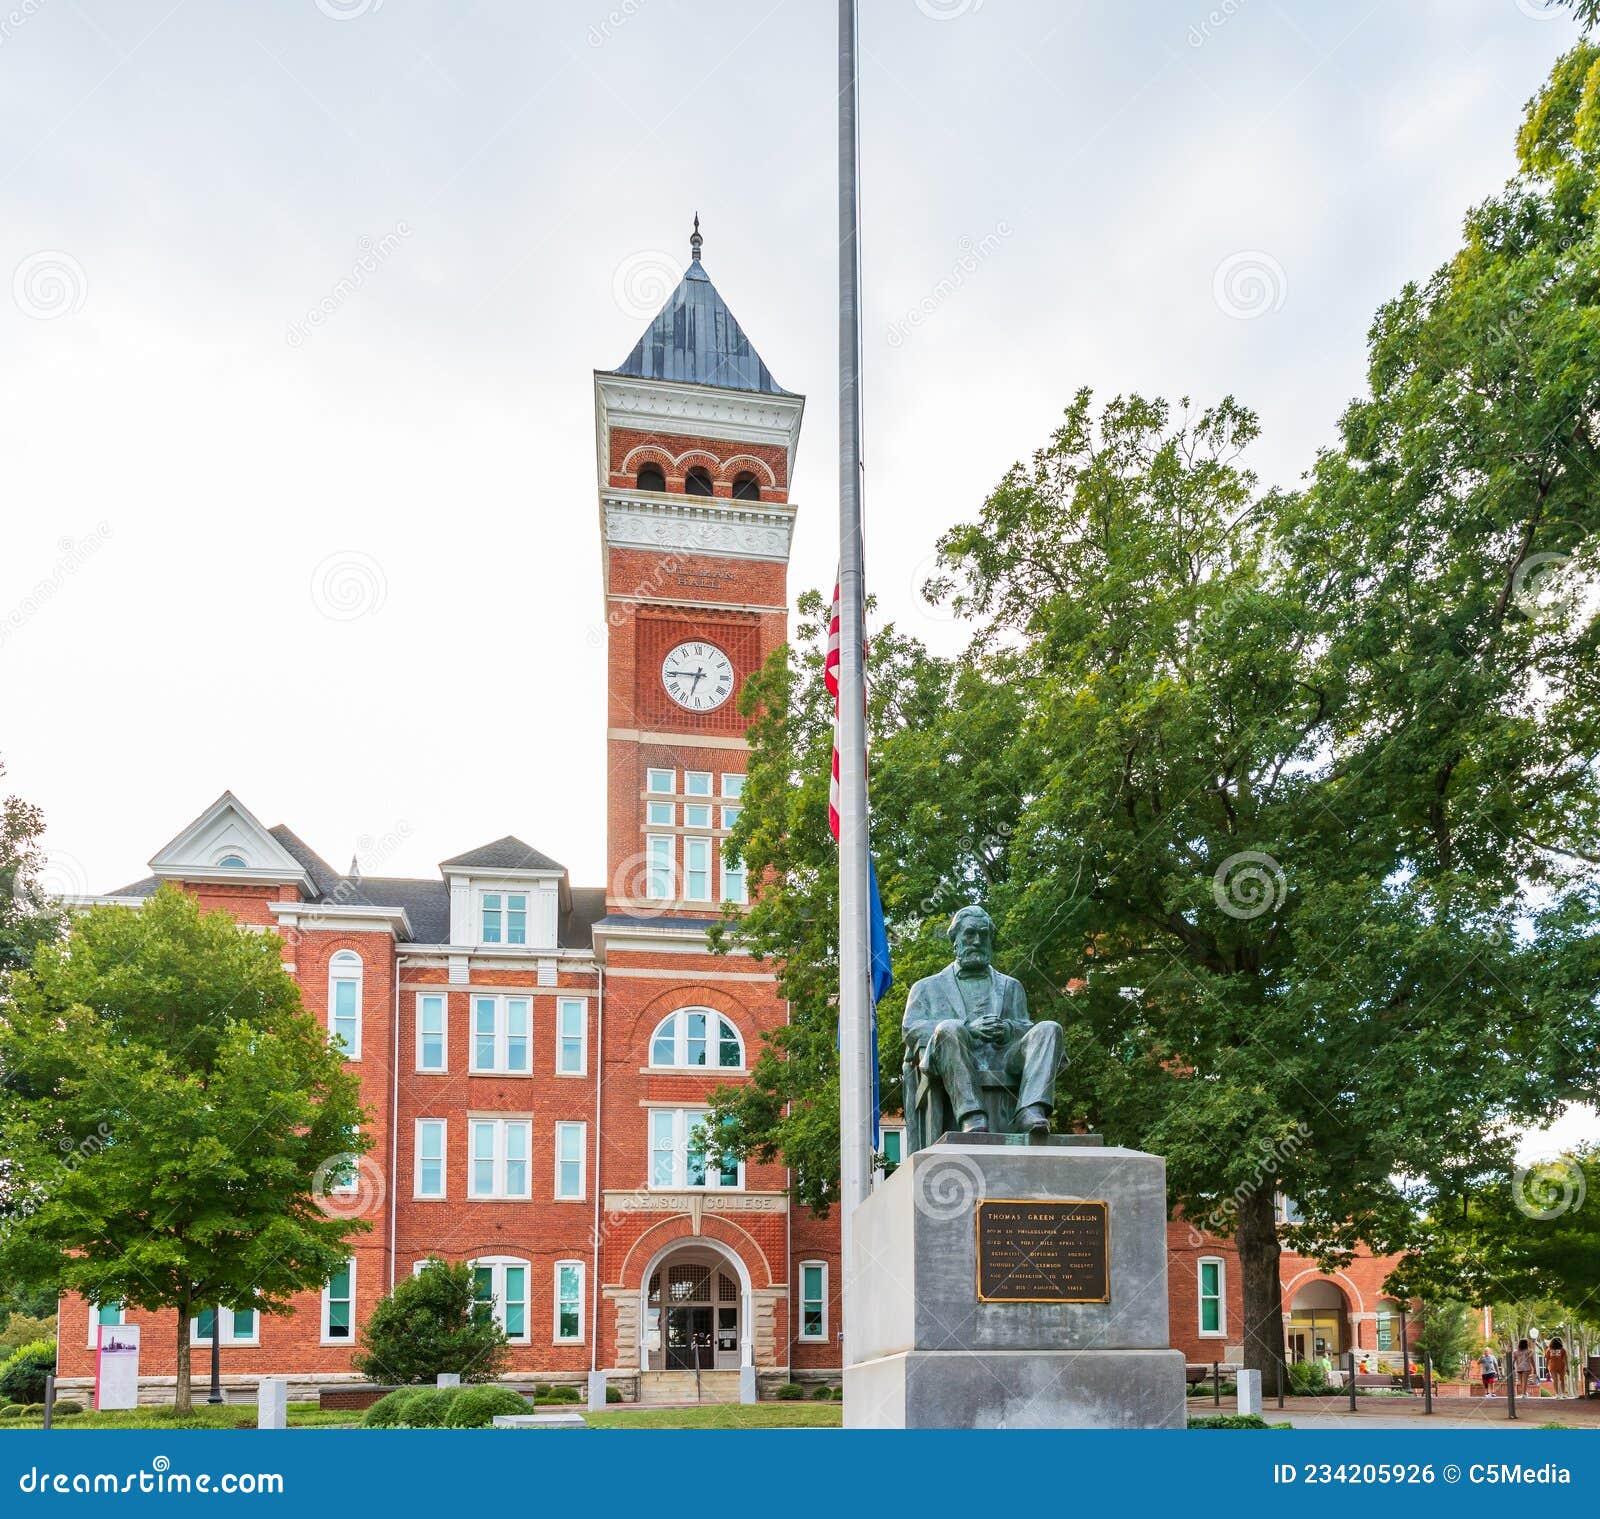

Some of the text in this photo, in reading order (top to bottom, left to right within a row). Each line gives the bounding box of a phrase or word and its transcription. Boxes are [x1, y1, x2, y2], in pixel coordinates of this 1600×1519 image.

[623, 1198, 689, 1210] CLEMSON
[988, 1213, 1021, 1221] THOMAS
[1061, 1214, 1097, 1222] CLEMSON
